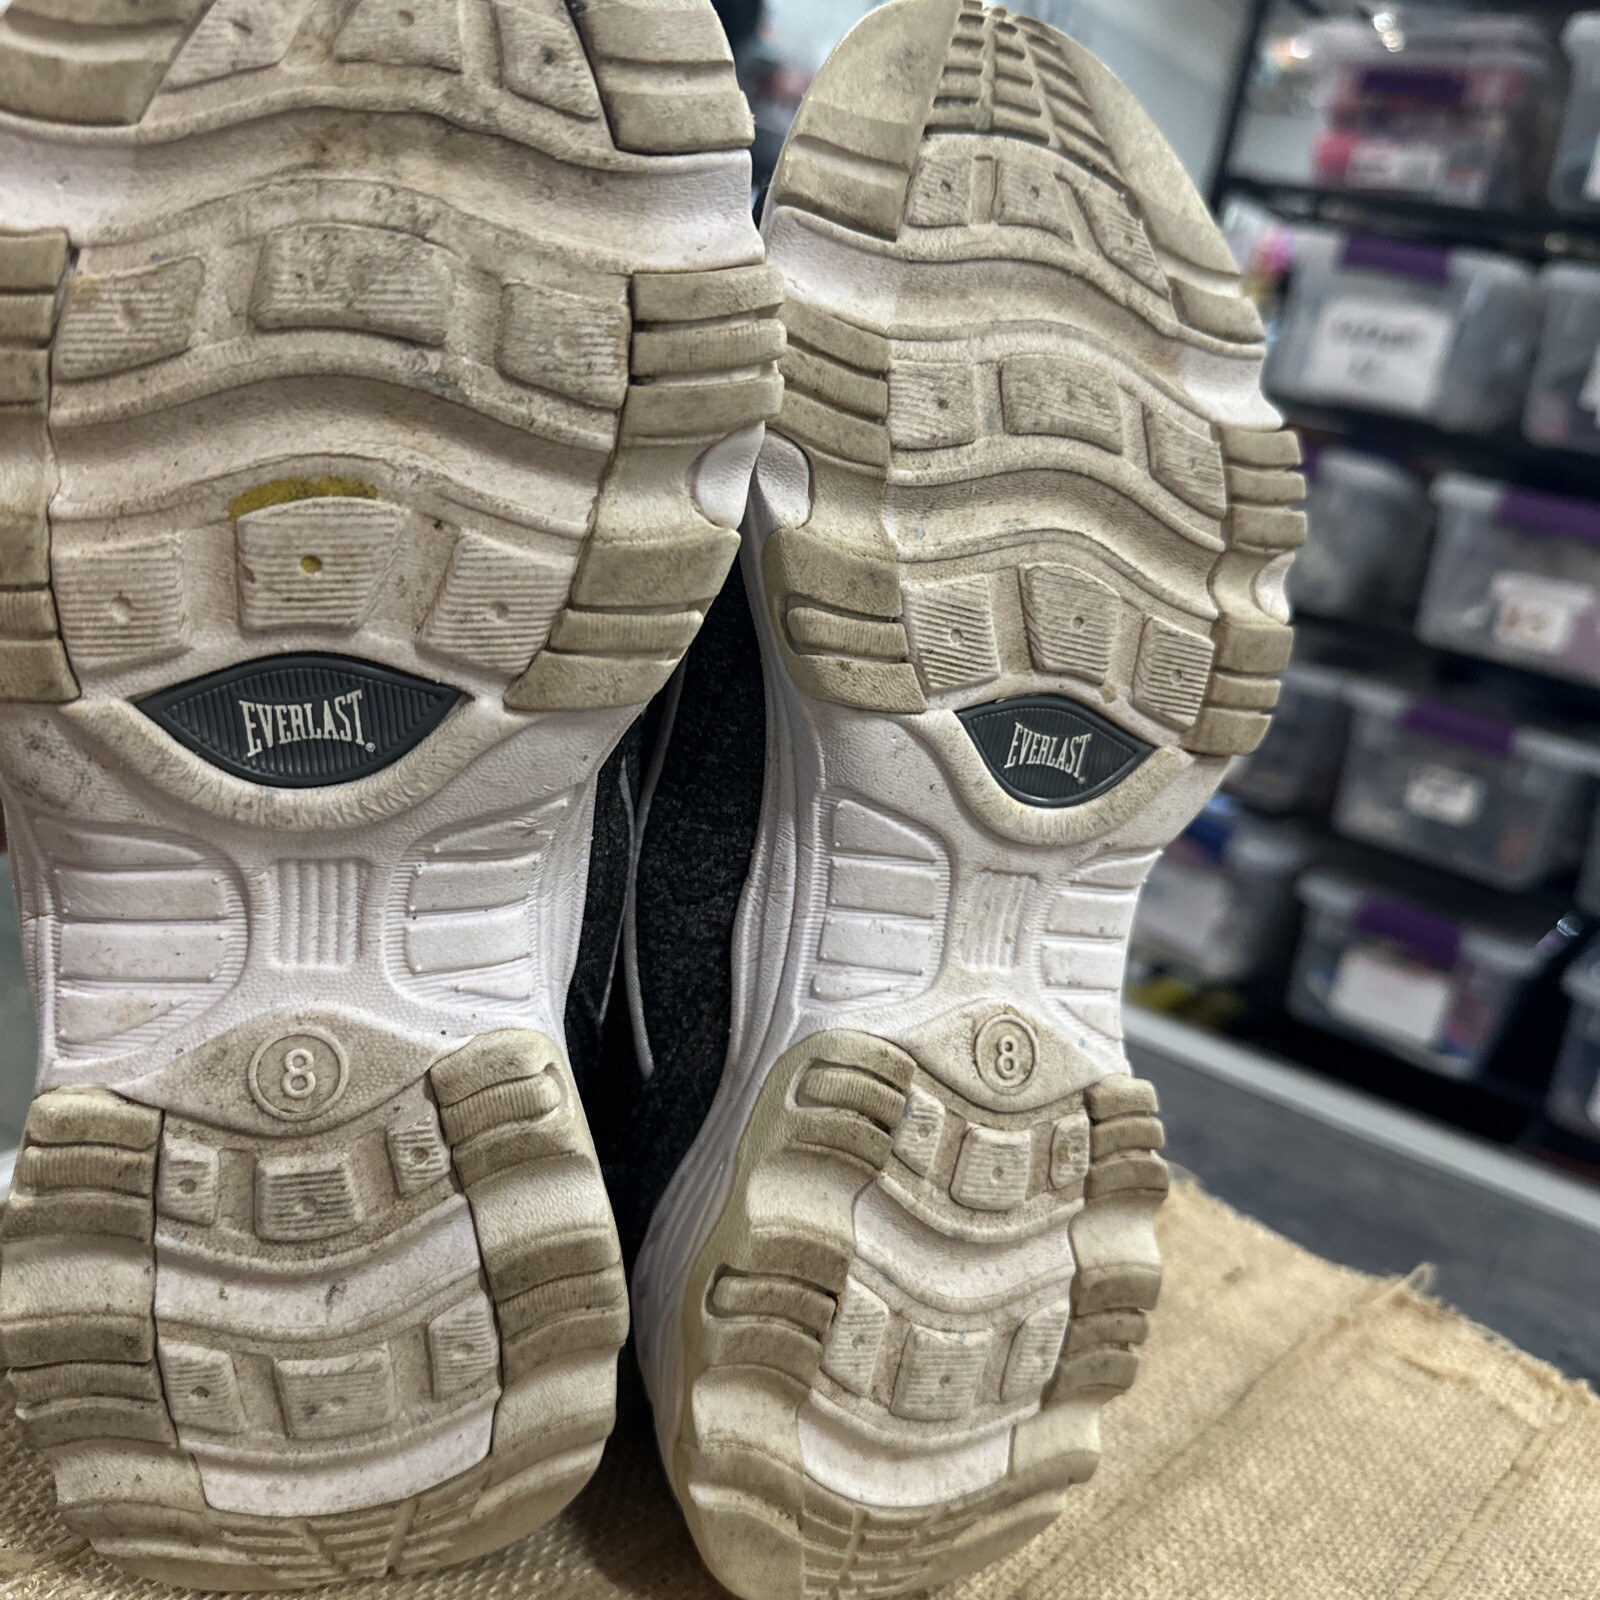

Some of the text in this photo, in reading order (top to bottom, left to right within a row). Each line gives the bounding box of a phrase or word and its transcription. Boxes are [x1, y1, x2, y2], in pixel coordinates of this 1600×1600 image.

[238, 689, 363, 758] EVERLAST
[1003, 721, 1093, 779] EVERLAST
[281, 1048, 317, 1099] 8
[996, 1035, 1020, 1080] 8
